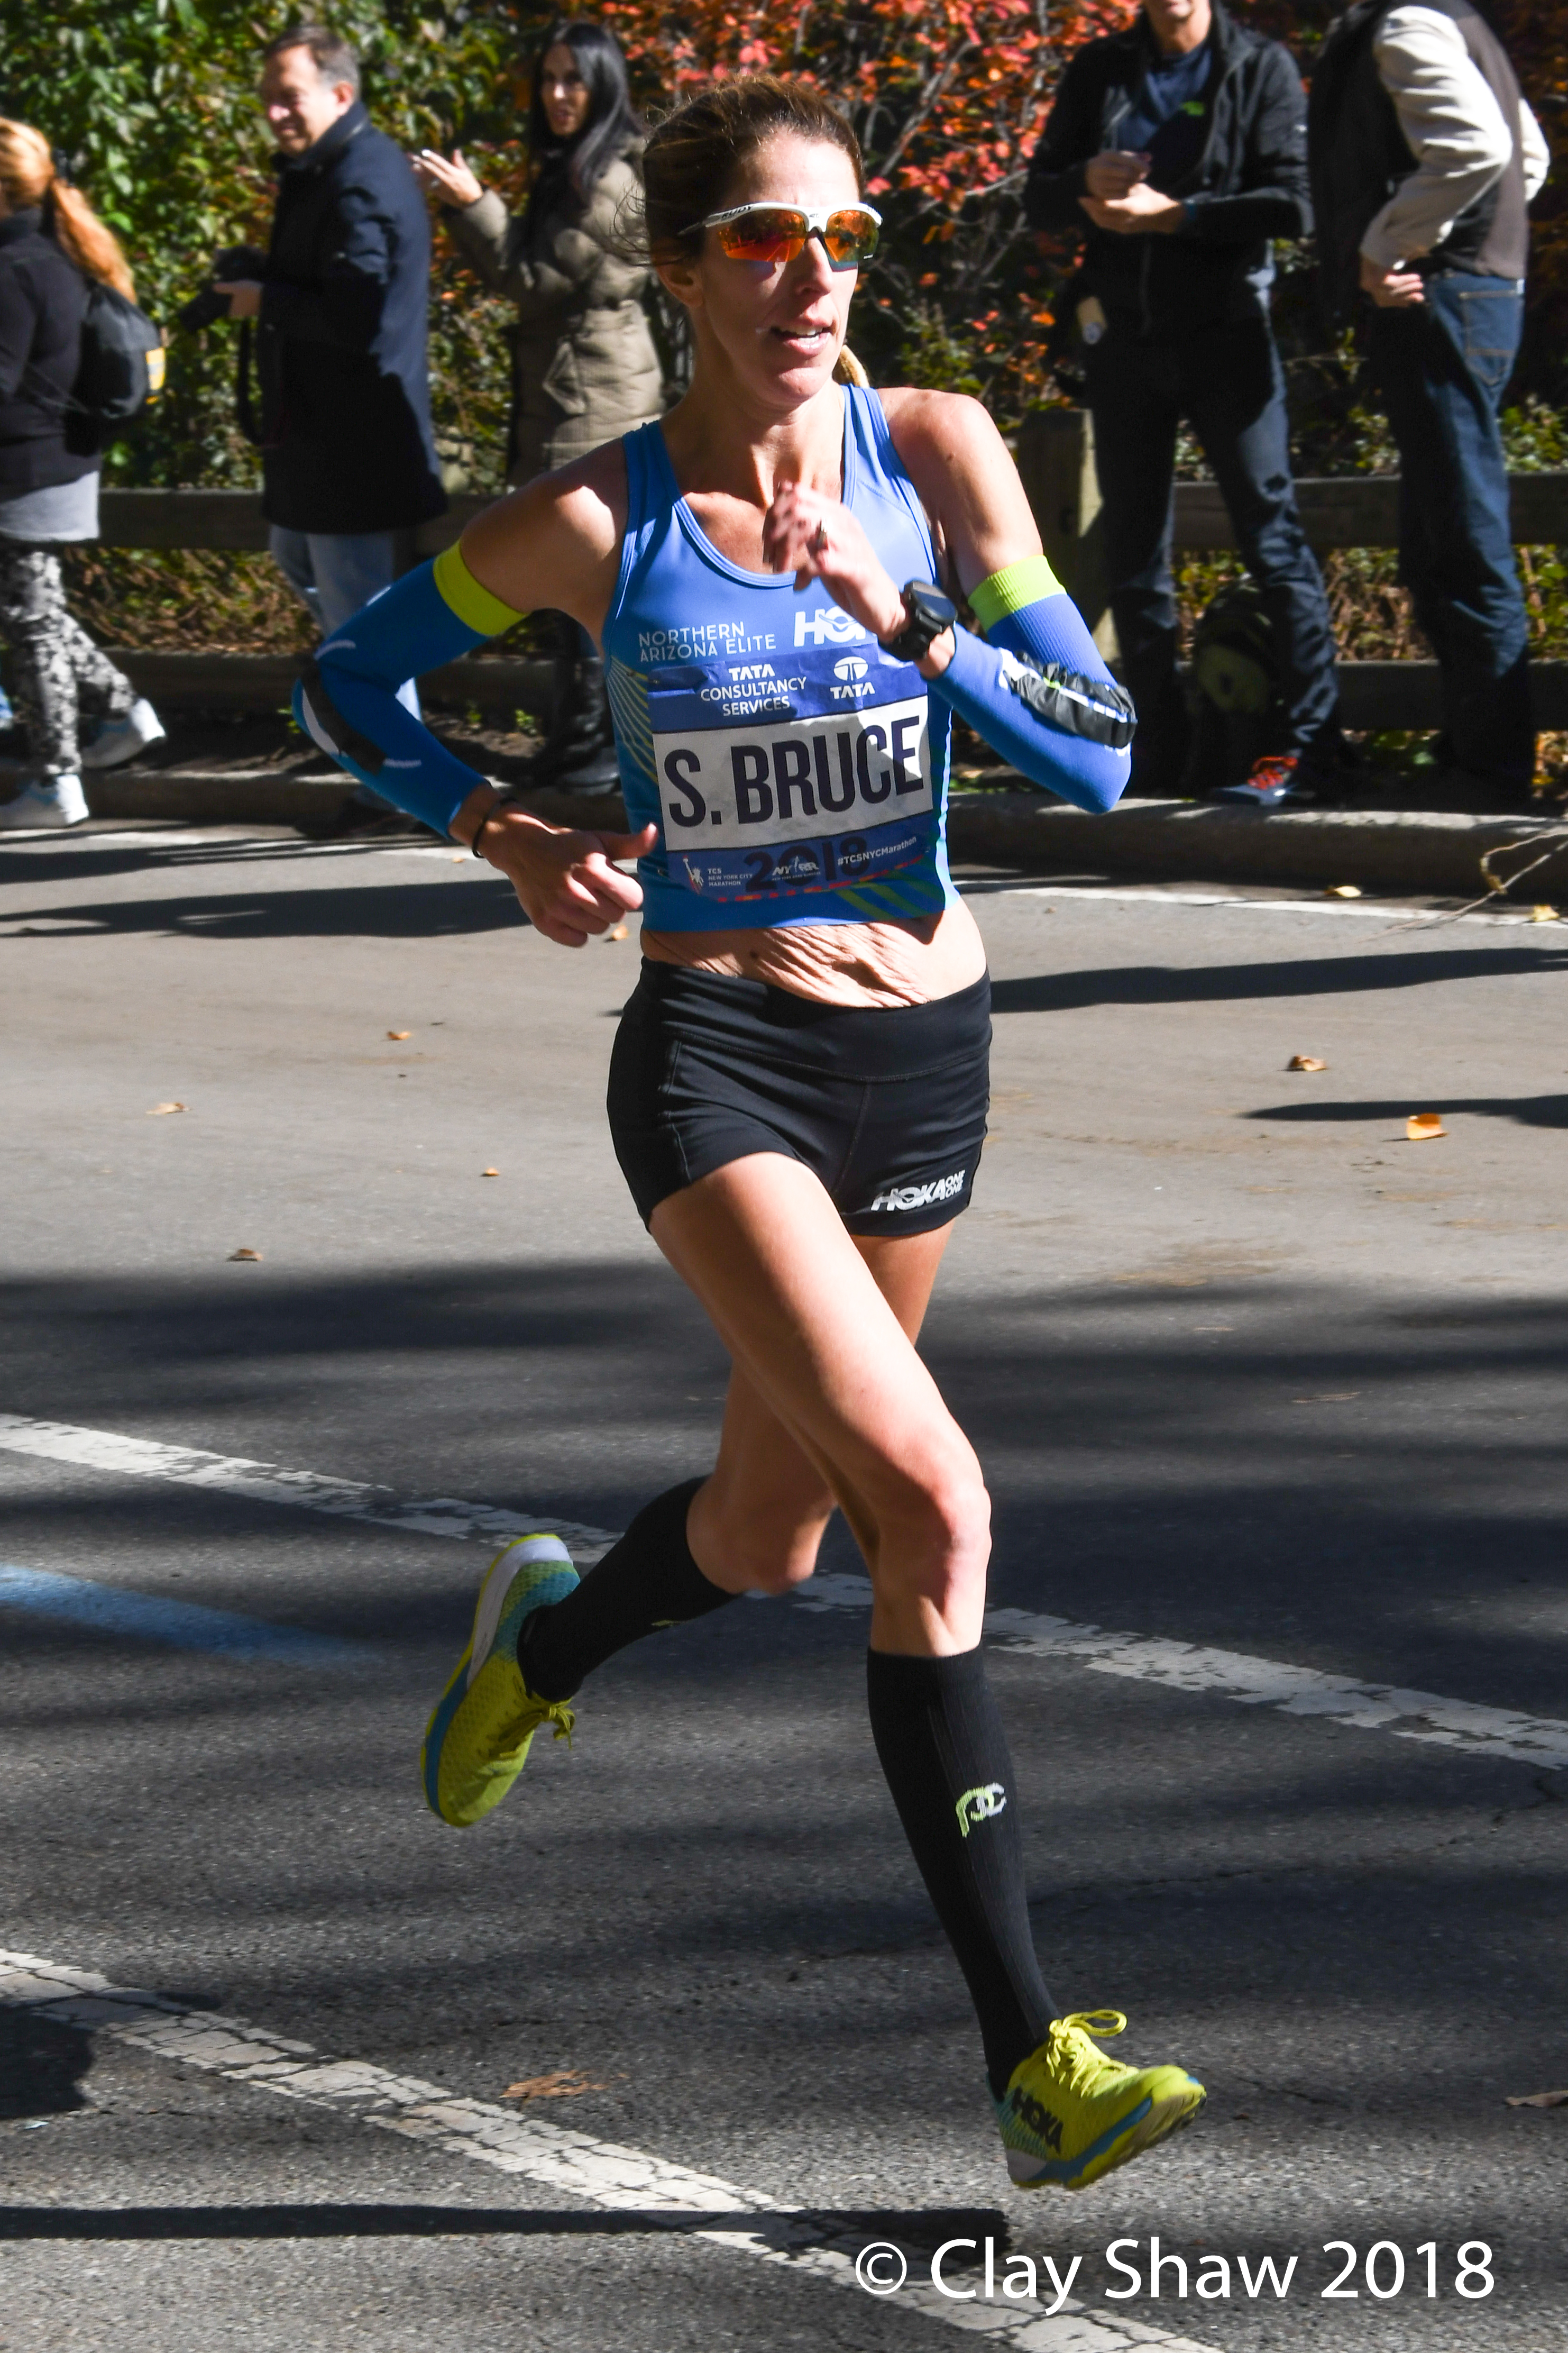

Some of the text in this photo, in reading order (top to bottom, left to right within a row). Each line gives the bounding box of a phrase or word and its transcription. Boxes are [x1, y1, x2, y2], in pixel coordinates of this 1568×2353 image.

[639, 621, 745, 647] NORTHERN
[640, 634, 776, 662] ARIZONA ELITE
[728, 663, 776, 681] TATA
[700, 676, 808, 701] CONSULTANCY
[830, 681, 876, 699] TATA
[722, 696, 790, 716] SERVICES
[664, 715, 924, 828] S. BRUCE
[838, 836, 917, 866] #TCSNYCMarathon
[870, 1178, 946, 1212] HOKA
